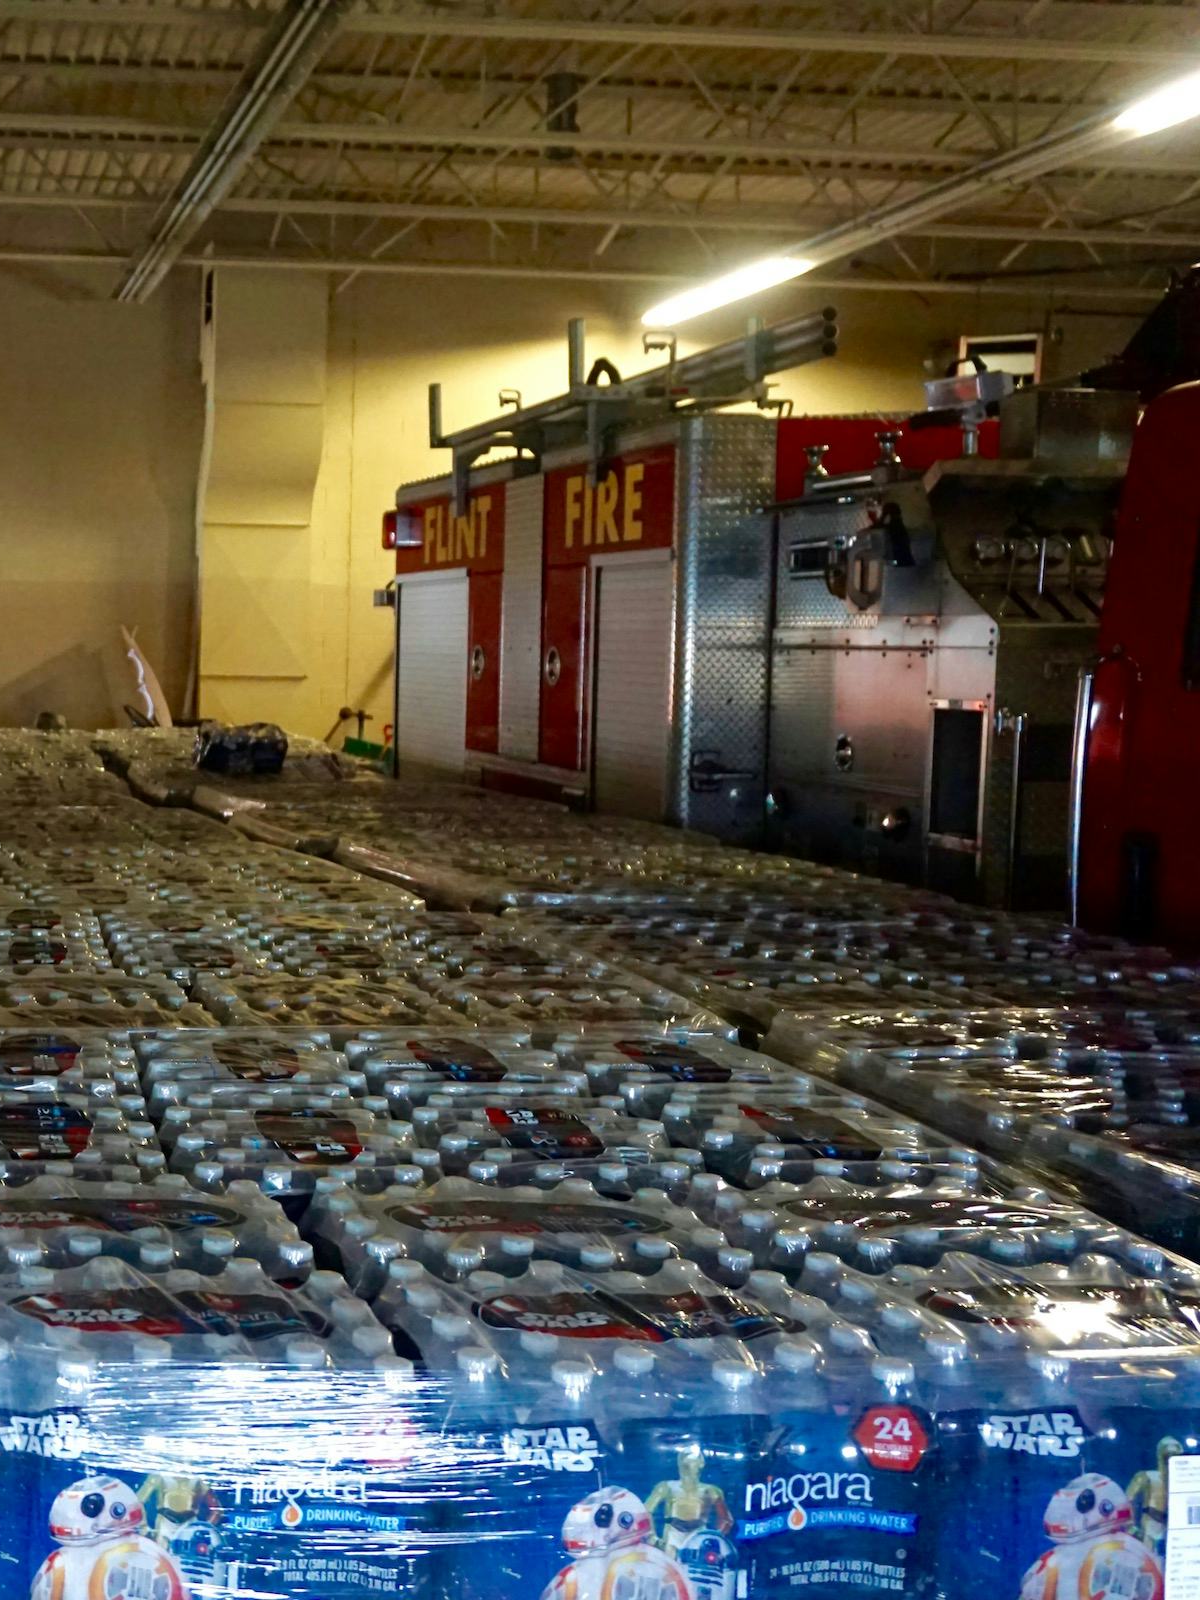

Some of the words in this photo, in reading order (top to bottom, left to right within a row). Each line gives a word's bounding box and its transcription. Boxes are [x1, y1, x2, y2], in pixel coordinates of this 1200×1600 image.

[565, 463, 644, 548] FIRE
[424, 495, 491, 564] FLINT
[10, 1414, 90, 1437] STAR
[873, 1417, 913, 1441] 24
[989, 1413, 1084, 1435] STAR
[511, 1427, 598, 1449] STAR
[978, 1423, 1085, 1457] WARS
[503, 1433, 599, 1472] WARS
[745, 1472, 874, 1531] niagara
[306, 1509, 362, 1524] DRINKING
[364, 1514, 400, 1531] WATER
[810, 1511, 866, 1525] DRINKING
[868, 1515, 908, 1530] WATER
[284, 1571, 305, 1582] TOTAL
[306, 1571, 326, 1582] 405.6
[874, 1563, 905, 1579] BOTTLES
